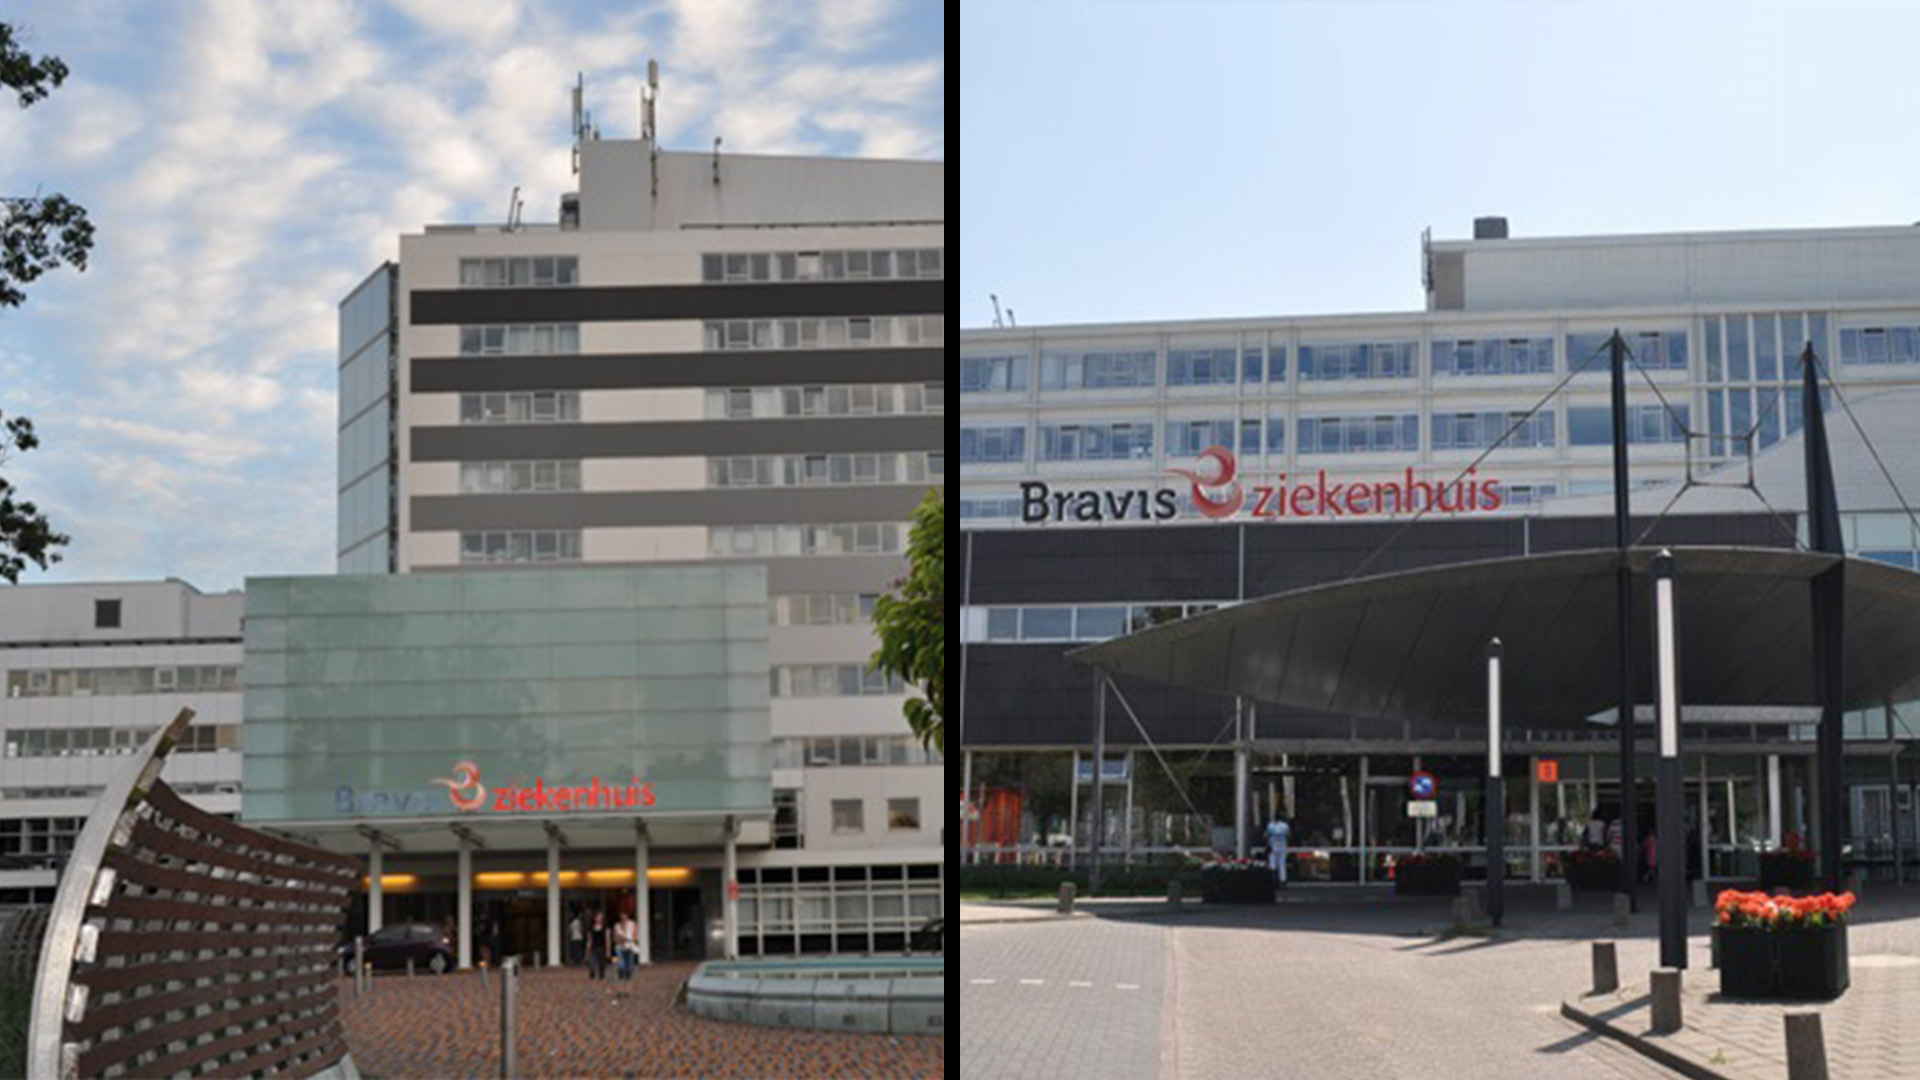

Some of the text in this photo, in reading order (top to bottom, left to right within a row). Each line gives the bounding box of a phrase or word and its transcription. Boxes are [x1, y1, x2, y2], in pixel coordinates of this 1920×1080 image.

[1020, 467, 1501, 523] Bravis ziekenhuis
[334, 777, 655, 813] Brav ziekenhuis
